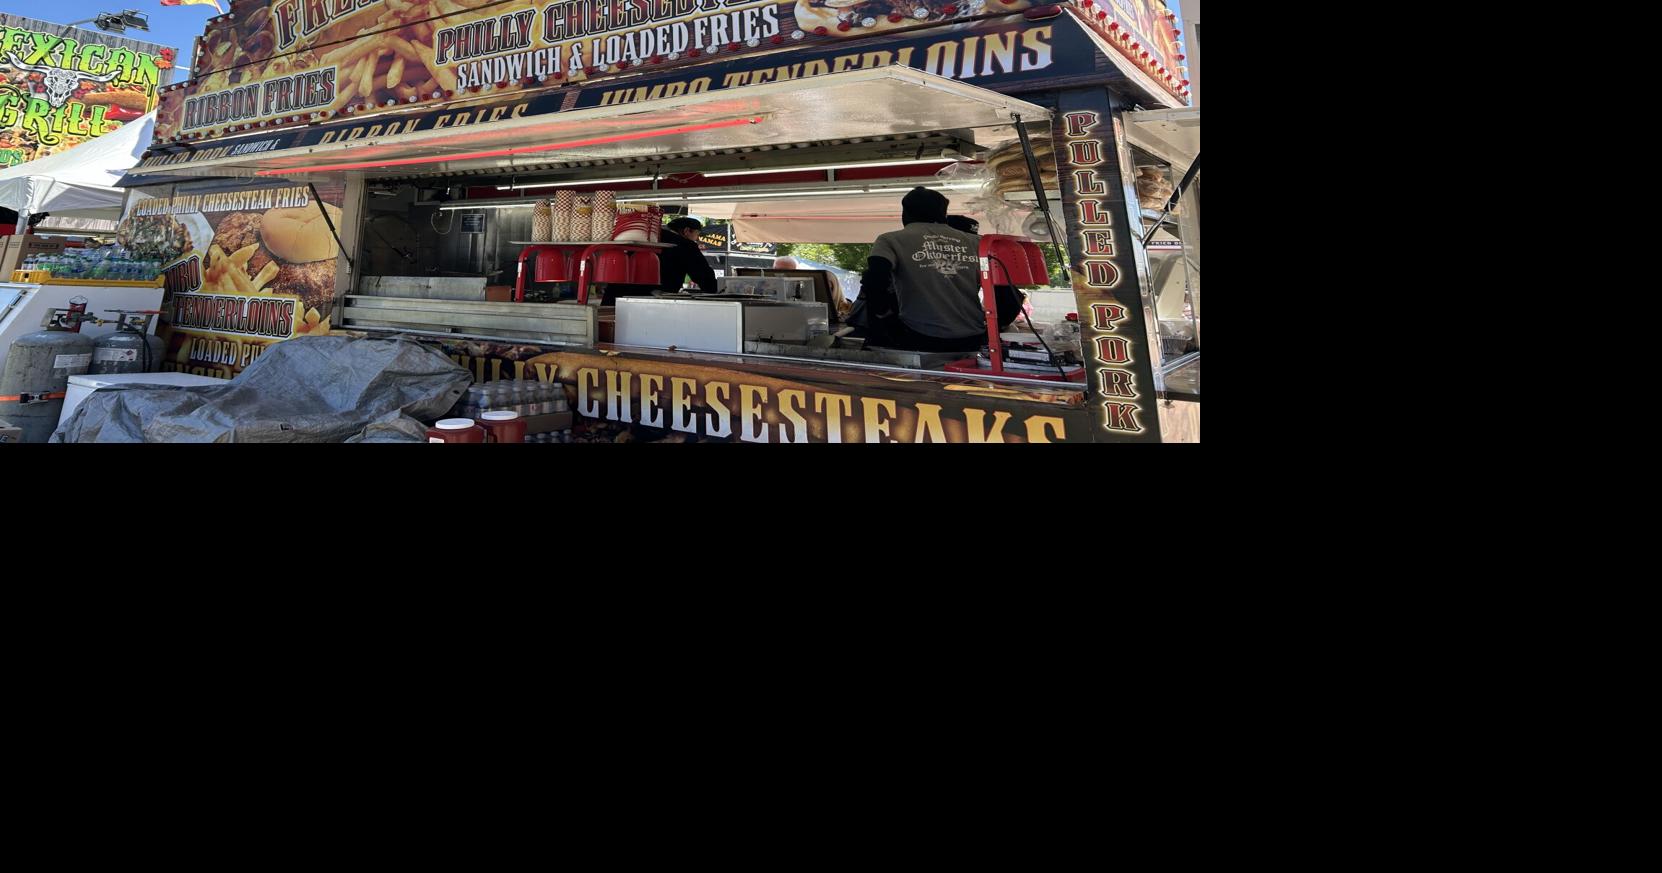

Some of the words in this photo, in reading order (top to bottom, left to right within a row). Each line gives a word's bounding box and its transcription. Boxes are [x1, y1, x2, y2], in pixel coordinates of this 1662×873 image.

[0, 27, 160, 88] EXICAN
[437, 12, 535, 64] PHILLY
[456, 47, 562, 90] SANDWICH
[568, 40, 584, 72] &
[592, 25, 689, 70] LOADED
[693, 5, 780, 49] FRIES
[0, 85, 106, 146] GRILL
[183, 83, 261, 130] RIBBON
[262, 67, 336, 116] FRIES
[136, 198, 171, 216] LOADED
[171, 193, 201, 215] PHILLY
[201, 189, 274, 213] CHEESESTEAK
[275, 185, 310, 208] FRIES
[1065, 111, 1120, 288] PULLED
[173, 293, 294, 338] TENDERLOINS
[189, 338, 237, 366] LOADED
[1091, 303, 1146, 433] PORK
